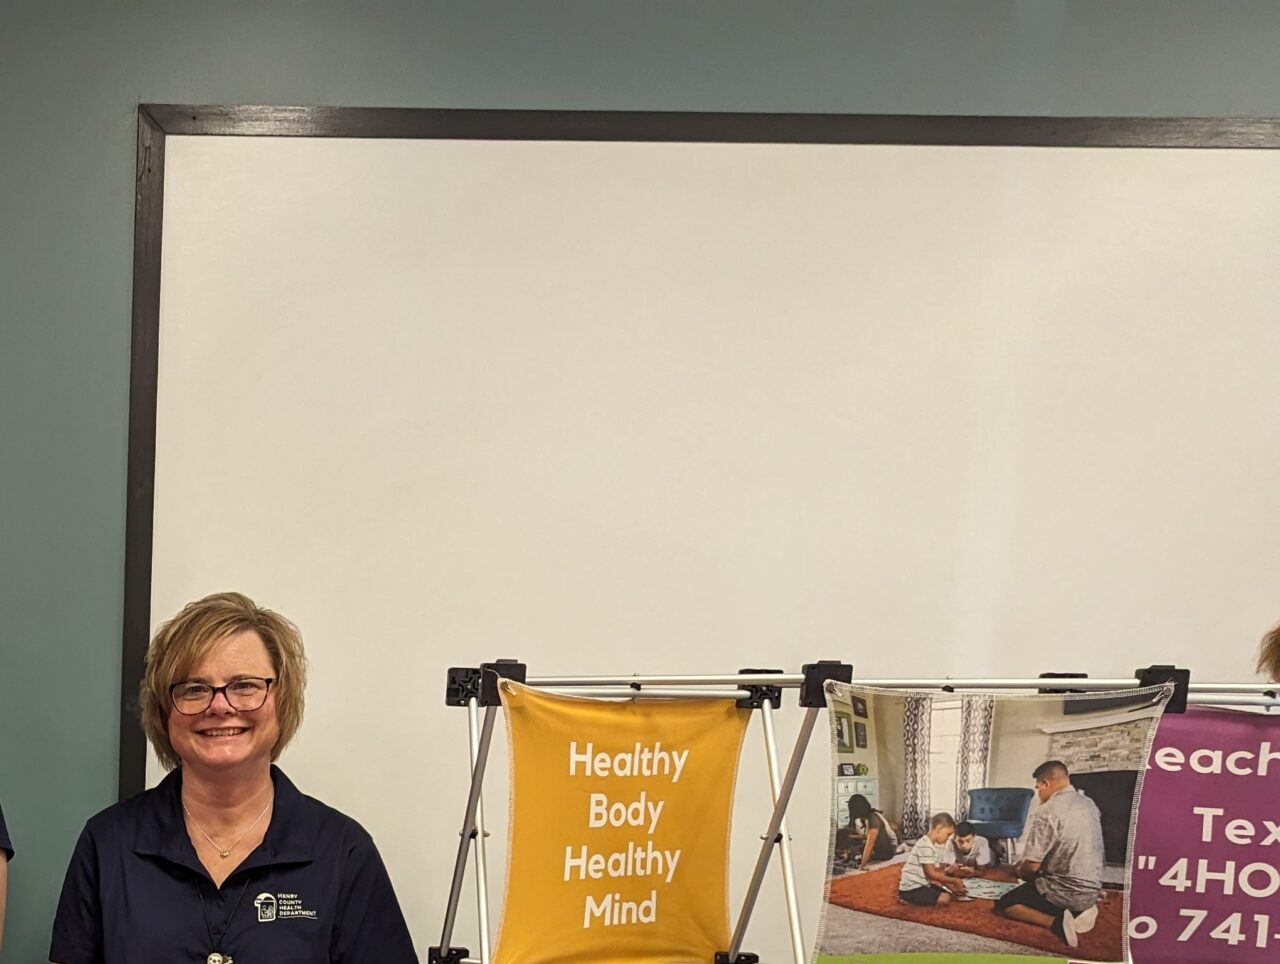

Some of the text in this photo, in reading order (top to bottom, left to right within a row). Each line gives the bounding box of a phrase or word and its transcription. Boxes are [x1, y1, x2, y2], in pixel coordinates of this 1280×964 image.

[569, 741, 689, 782] Healthy
[1145, 742, 1280, 776] each
[588, 792, 664, 834] Body
[563, 841, 681, 883] Healthy
[583, 890, 657, 929] Mind
[1128, 915, 1158, 939] o
